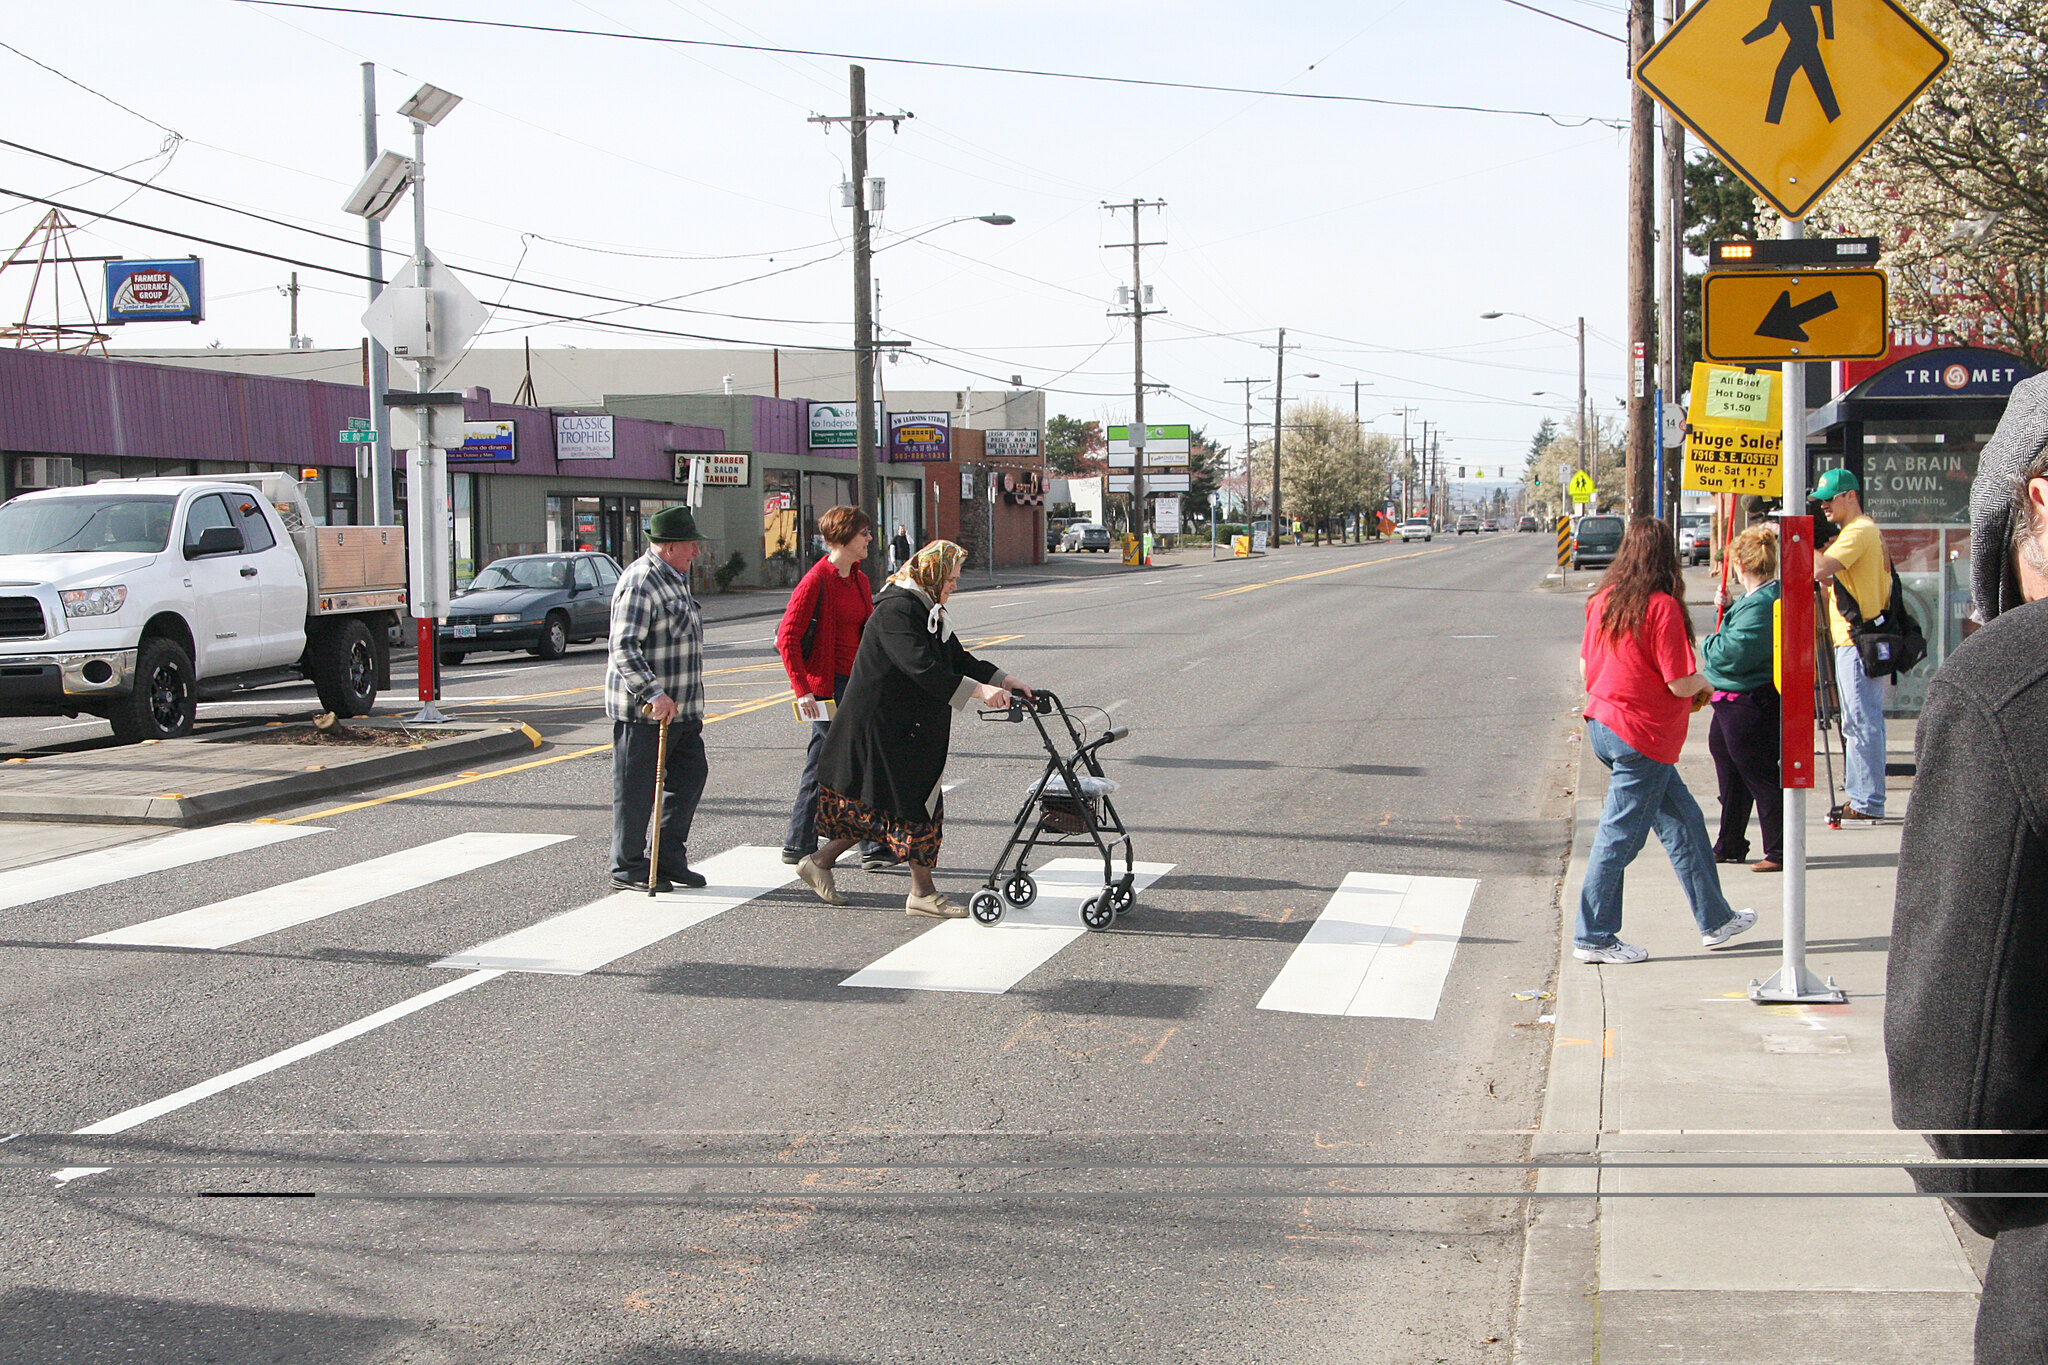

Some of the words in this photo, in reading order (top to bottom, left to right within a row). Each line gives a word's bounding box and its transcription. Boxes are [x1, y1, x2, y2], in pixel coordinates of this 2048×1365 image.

[134, 274, 167, 283] FARMERS
[133, 283, 168, 291] INSURANCE
[139, 291, 163, 299] GROUP
[1905, 370, 1940, 384] TRI
[1972, 368, 2015, 383] MET
[1720, 377, 1734, 385] All
[1736, 378, 1760, 388] Beef
[1715, 389, 1733, 398] Hot
[1736, 391, 1761, 401] Dogs
[1723, 402, 1751, 413] $1.50
[562, 417, 607, 430] CLASSIC
[902, 415, 927, 423] LEARNING
[928, 415, 946, 423] STUDIO
[1666, 418, 1676, 427] 14
[341, 433, 349, 441] SE
[560, 430, 611, 444] TROPHIES
[1692, 431, 1734, 449] Huge
[1740, 434, 1780, 450] Sale!
[714, 456, 744, 464] BARBER
[1692, 450, 1715, 461] 7916
[1740, 454, 1777, 466] FOSTER
[1816, 457, 1833, 471] IT
[1884, 457, 1898, 471] A
[1905, 456, 1962, 471] BRAIN
[714, 466, 739, 474] SALON
[1695, 463, 1716, 474] Wed
[1724, 465, 1740, 476] Sat
[1746, 467, 1757, 477] 11
[1767, 468, 1773, 478] 7
[705, 475, 738, 484] TANNING
[1699, 476, 1723, 486] Sun
[1731, 478, 1745, 488] 11
[1758, 479, 1766, 489] 5
[1863, 477, 1883, 491] TS
[1891, 476, 1944, 491] OWN.
